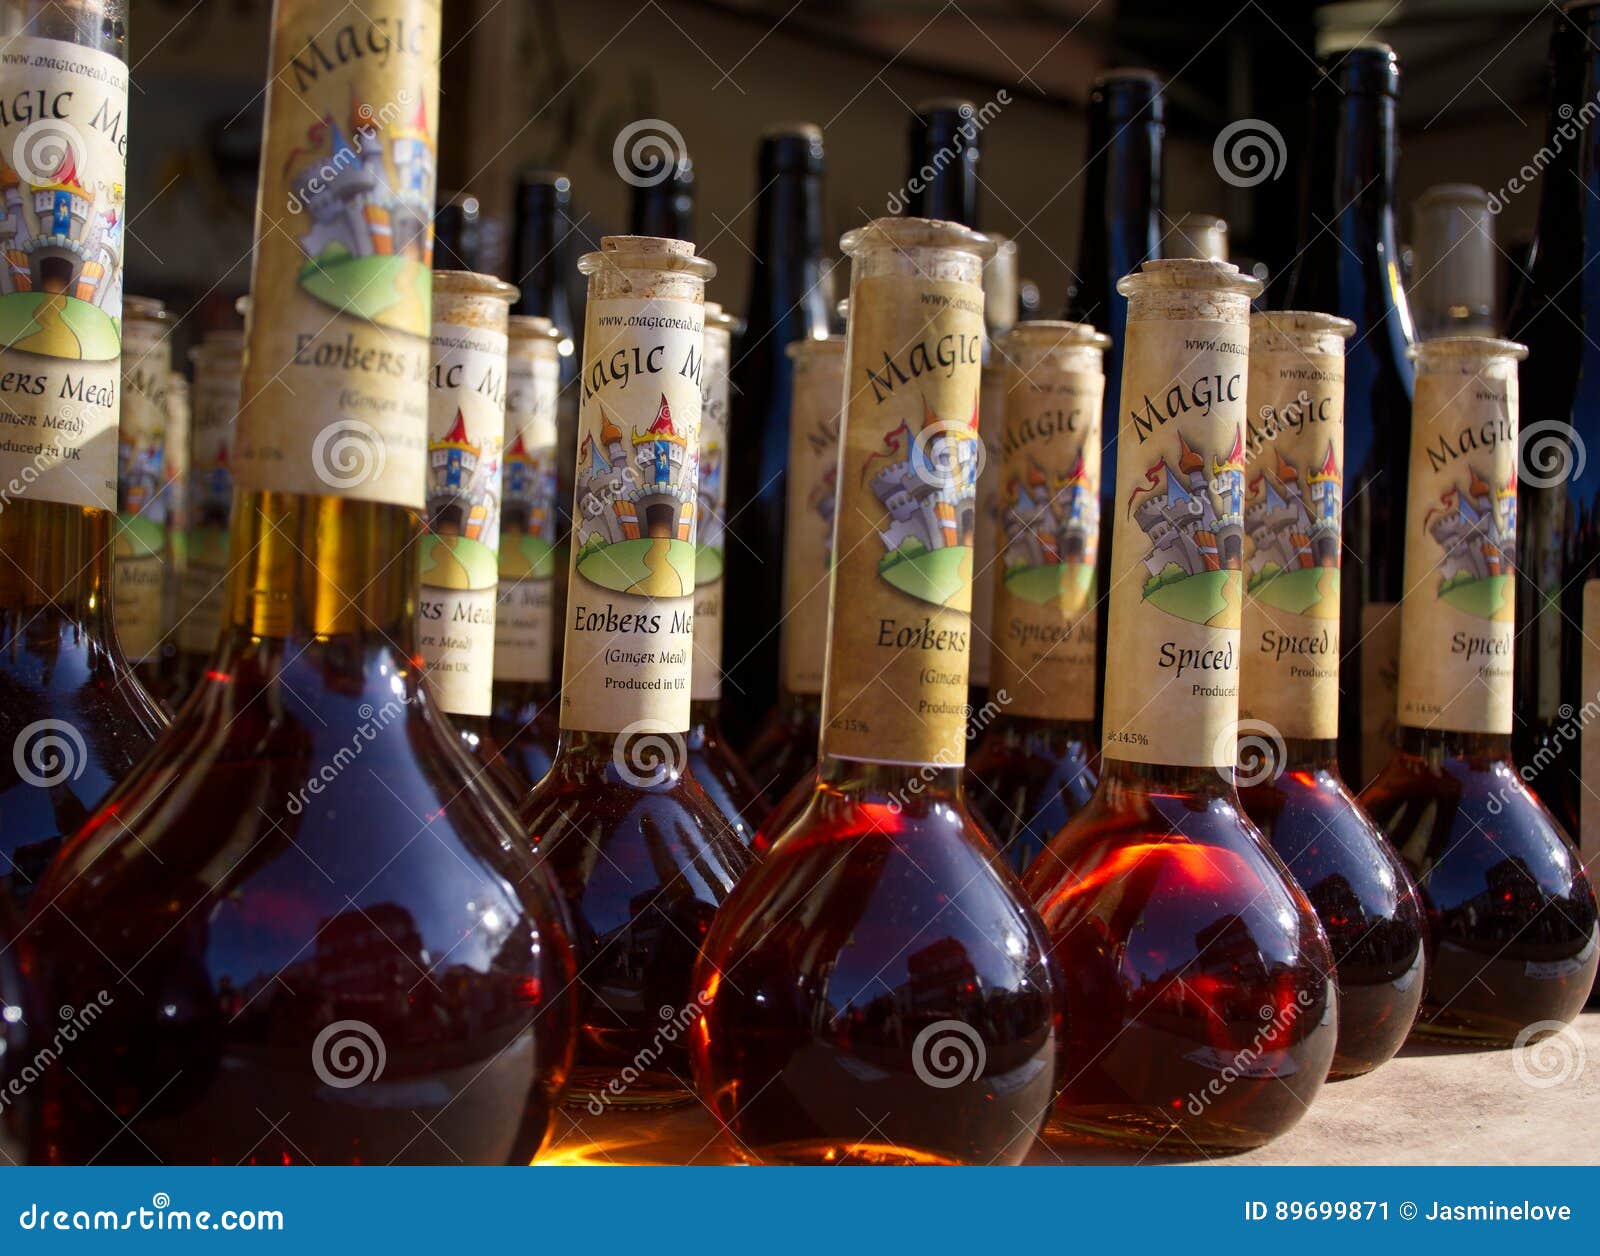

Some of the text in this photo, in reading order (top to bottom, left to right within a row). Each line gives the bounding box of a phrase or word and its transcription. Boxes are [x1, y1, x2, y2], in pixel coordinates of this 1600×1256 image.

[1158, 640, 1233, 679] Spiced
[1260, 628, 1329, 662] Spiced
[1451, 631, 1511, 662] Spiced
[605, 676, 686, 690] Produced in UK
[1118, 732, 1149, 745] 14.5%
